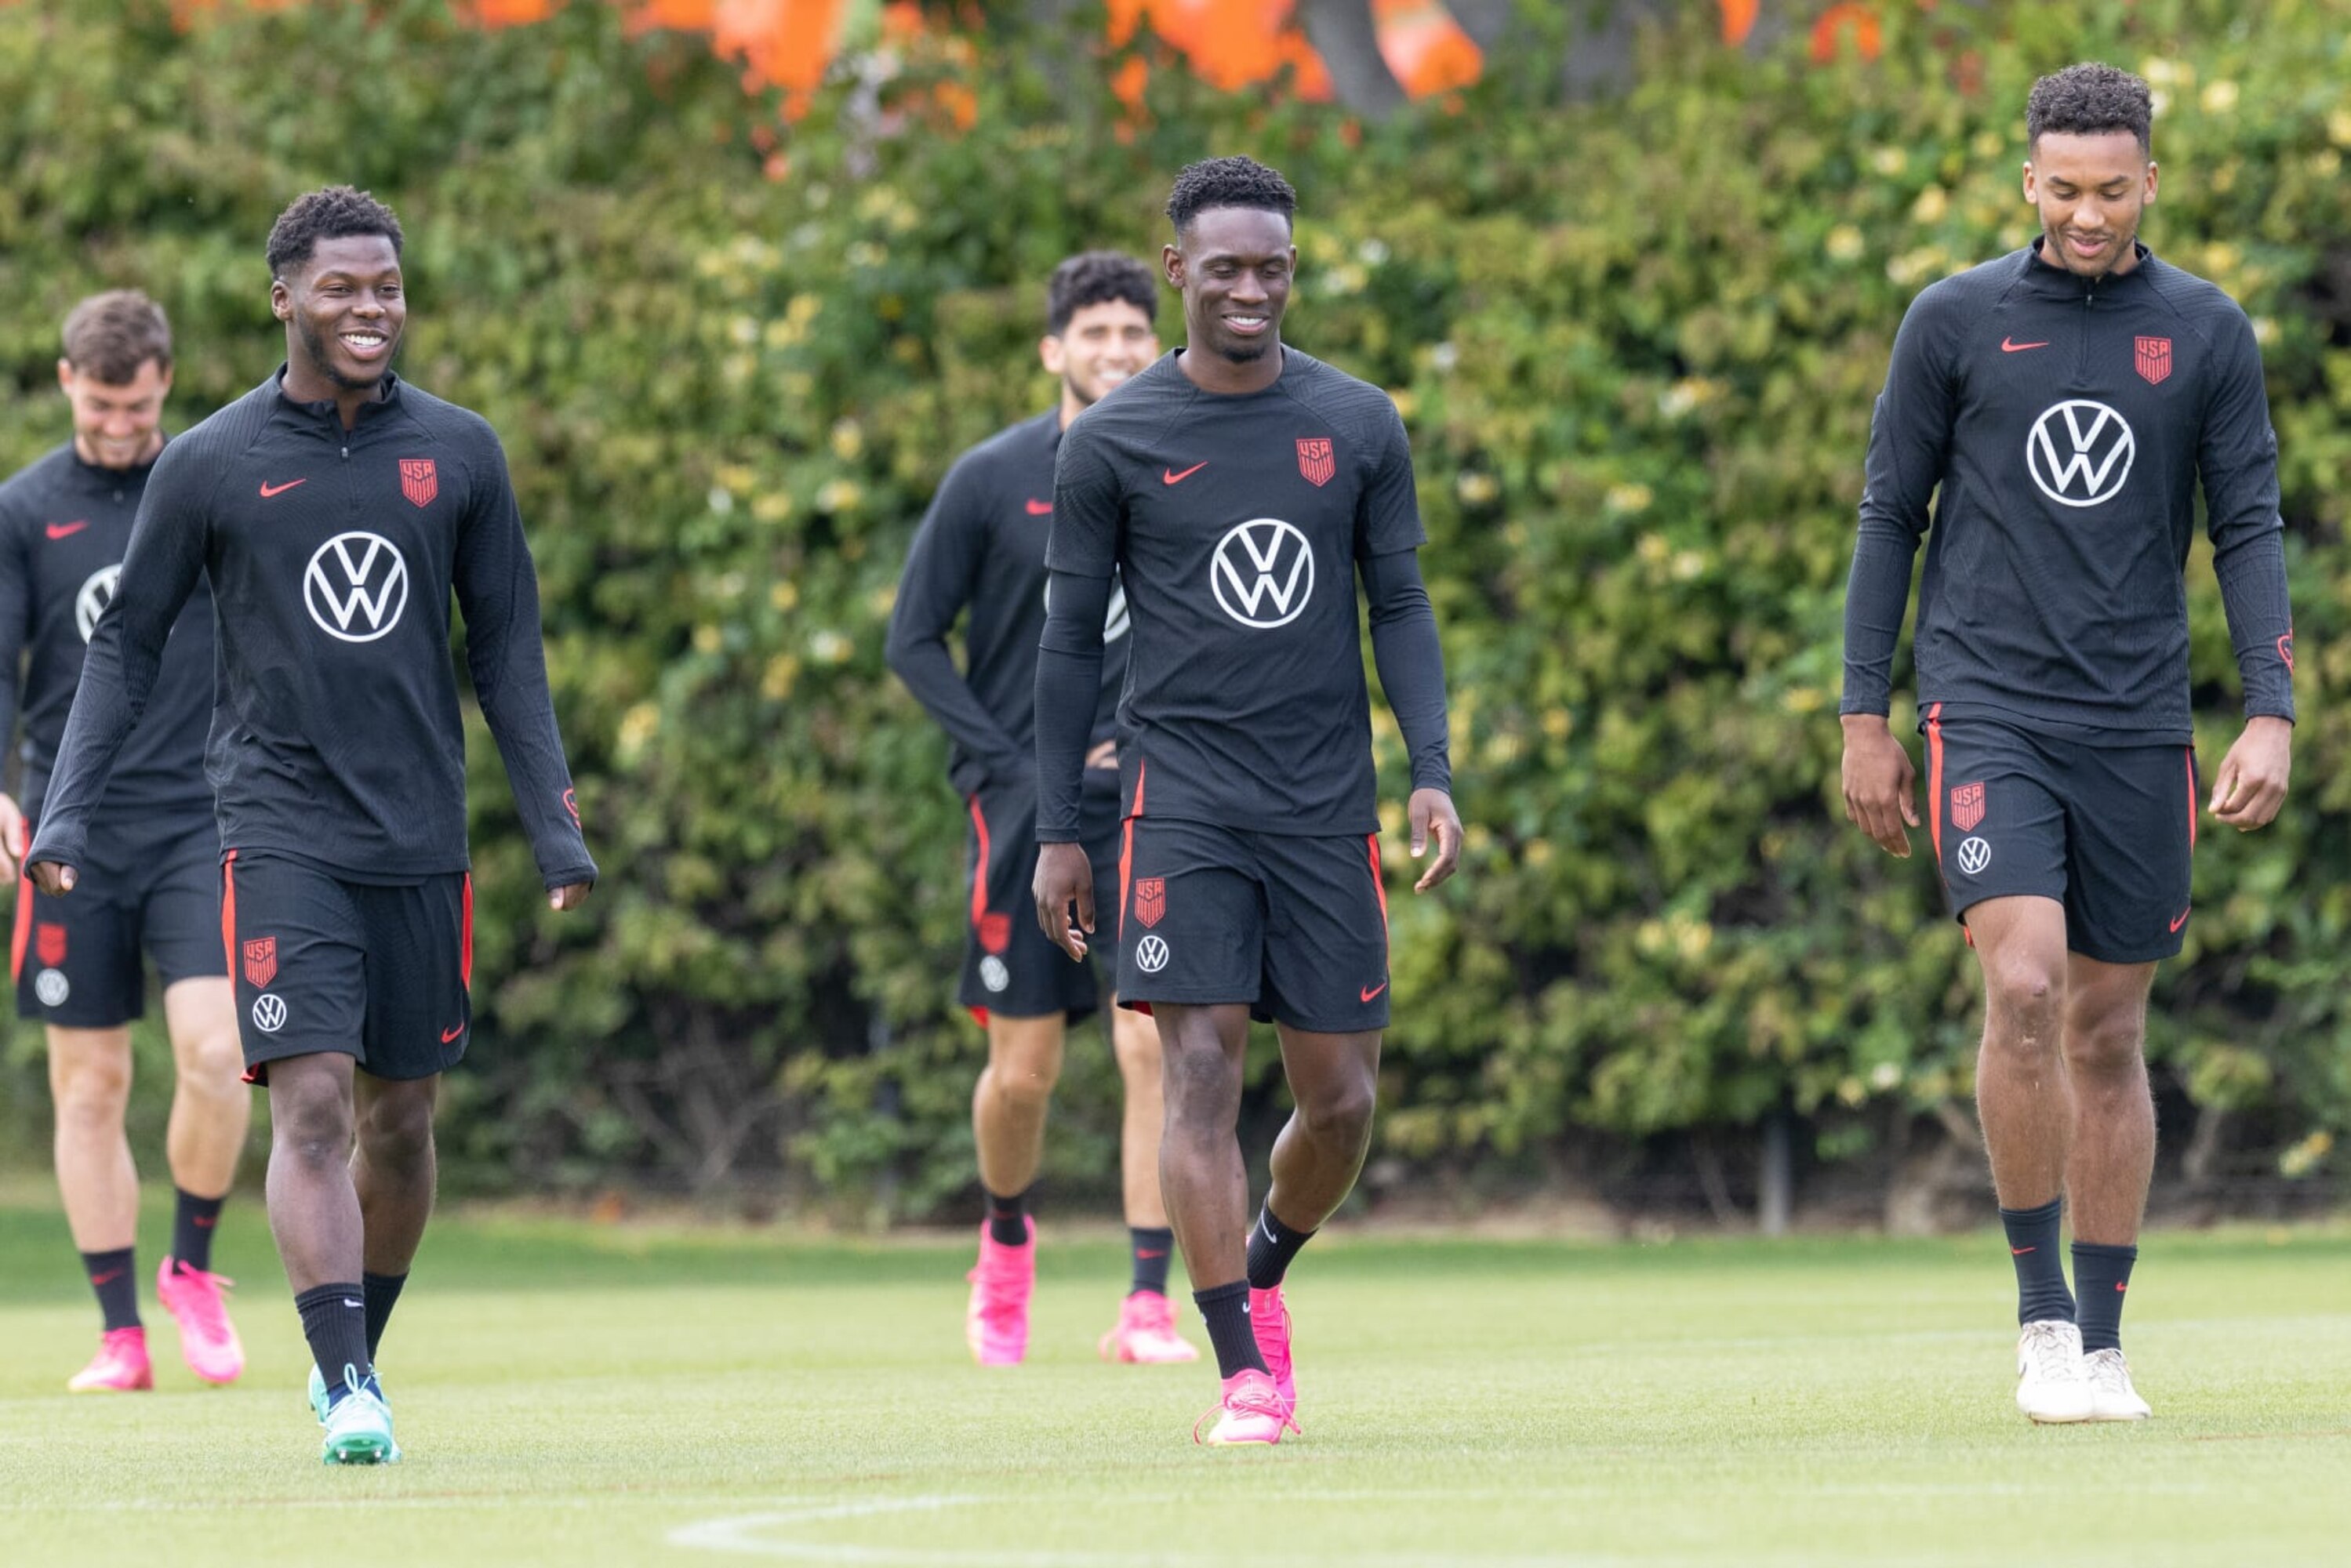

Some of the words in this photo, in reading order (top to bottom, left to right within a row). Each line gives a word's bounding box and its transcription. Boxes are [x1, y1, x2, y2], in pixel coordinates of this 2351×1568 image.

[2138, 338, 2169, 359] USA
[1299, 441, 1331, 460] USA
[402, 462, 433, 480] USA
[1953, 784, 1982, 806] USA
[1138, 880, 1164, 901] USA
[246, 941, 274, 962] USA
